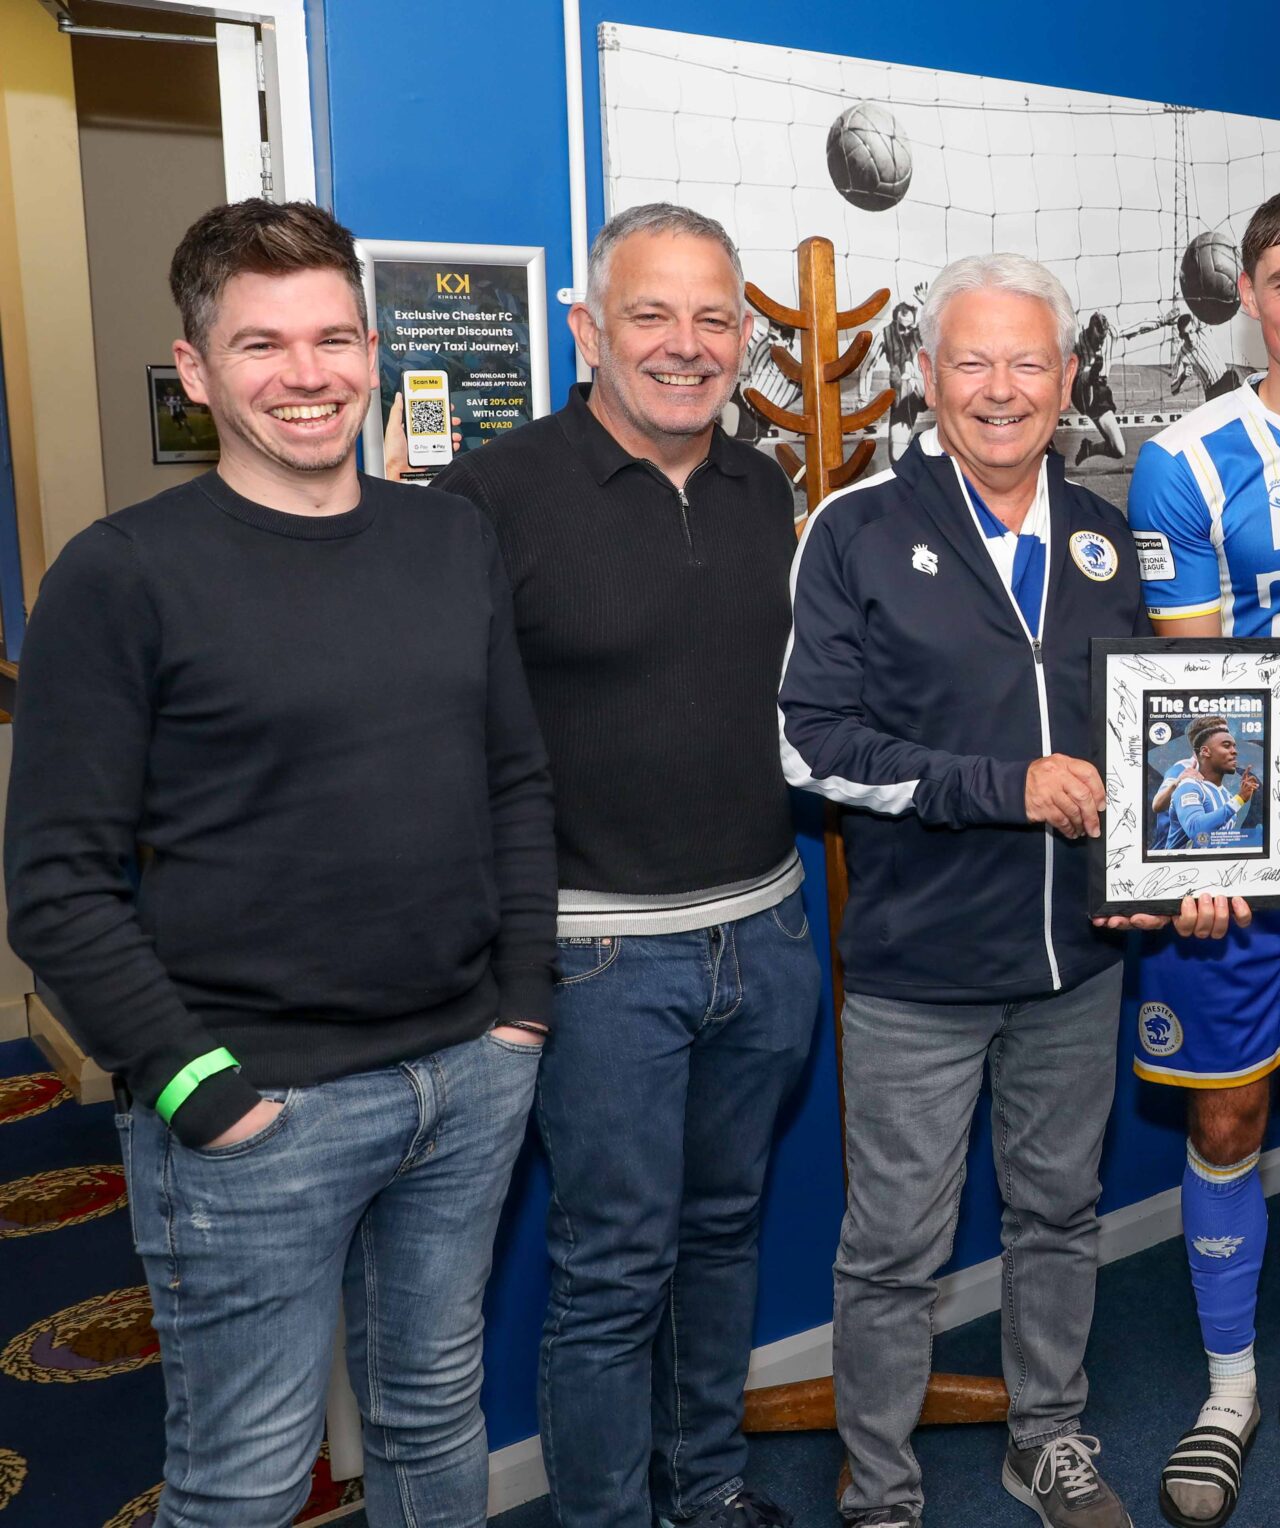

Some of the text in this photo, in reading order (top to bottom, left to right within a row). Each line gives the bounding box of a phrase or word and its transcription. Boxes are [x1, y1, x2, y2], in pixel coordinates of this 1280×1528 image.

[394, 310, 513, 321] Exclusive Chester FC
[396, 326, 513, 338] Supporter Discounts
[391, 341, 519, 354] on Every Taxi Journey!
[466, 398, 488, 406] SAVE
[489, 398, 507, 406] 20%
[472, 410, 495, 418] WITH
[480, 421, 513, 429] DEVA20
[1075, 533, 1105, 544] CHESTER
[1143, 563, 1165, 571] EAGUE
[1149, 696, 1262, 713] The Cestrian
[1246, 721, 1262, 733] 03
[1142, 1005, 1174, 1020] CHESTER
